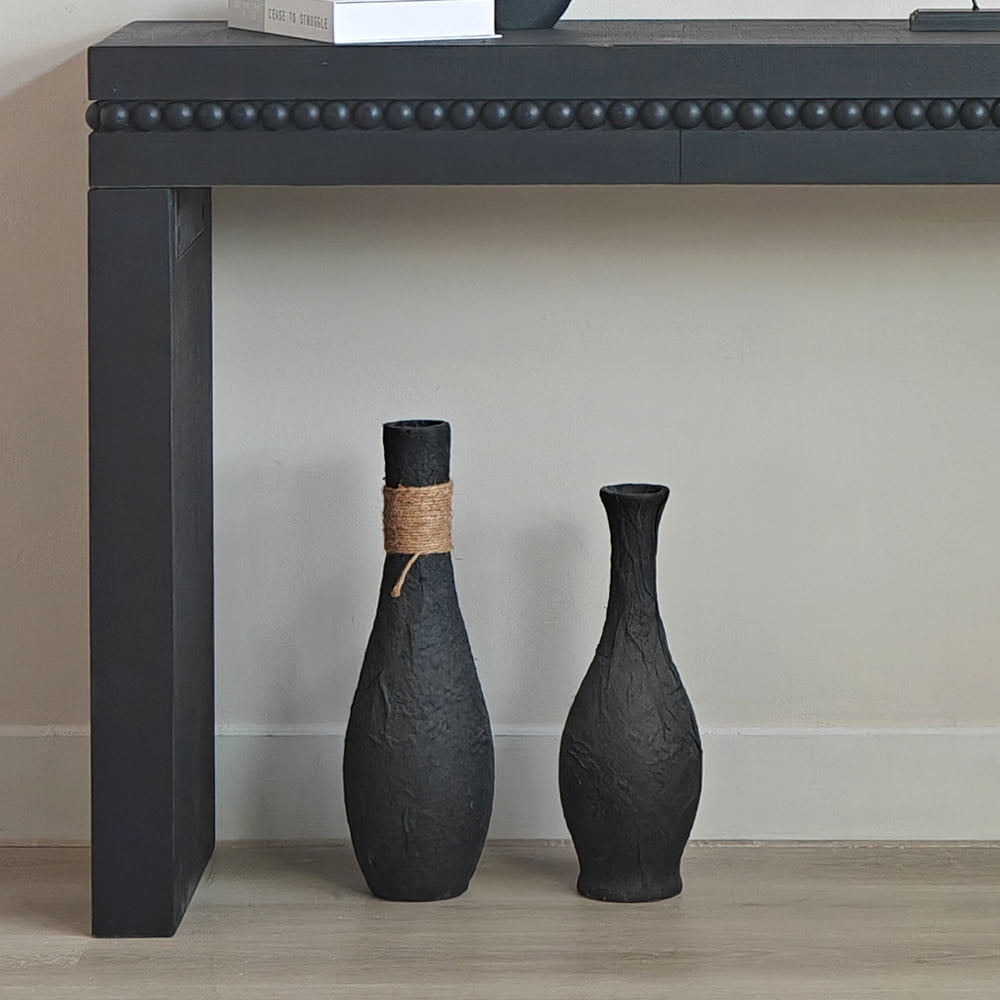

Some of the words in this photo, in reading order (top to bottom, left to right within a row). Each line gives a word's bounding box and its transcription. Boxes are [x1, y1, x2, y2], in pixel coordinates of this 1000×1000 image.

[268, 8, 286, 22] CEASE
[289, 11, 297, 24] TO
[300, 13, 328, 30] STRUGGLE
